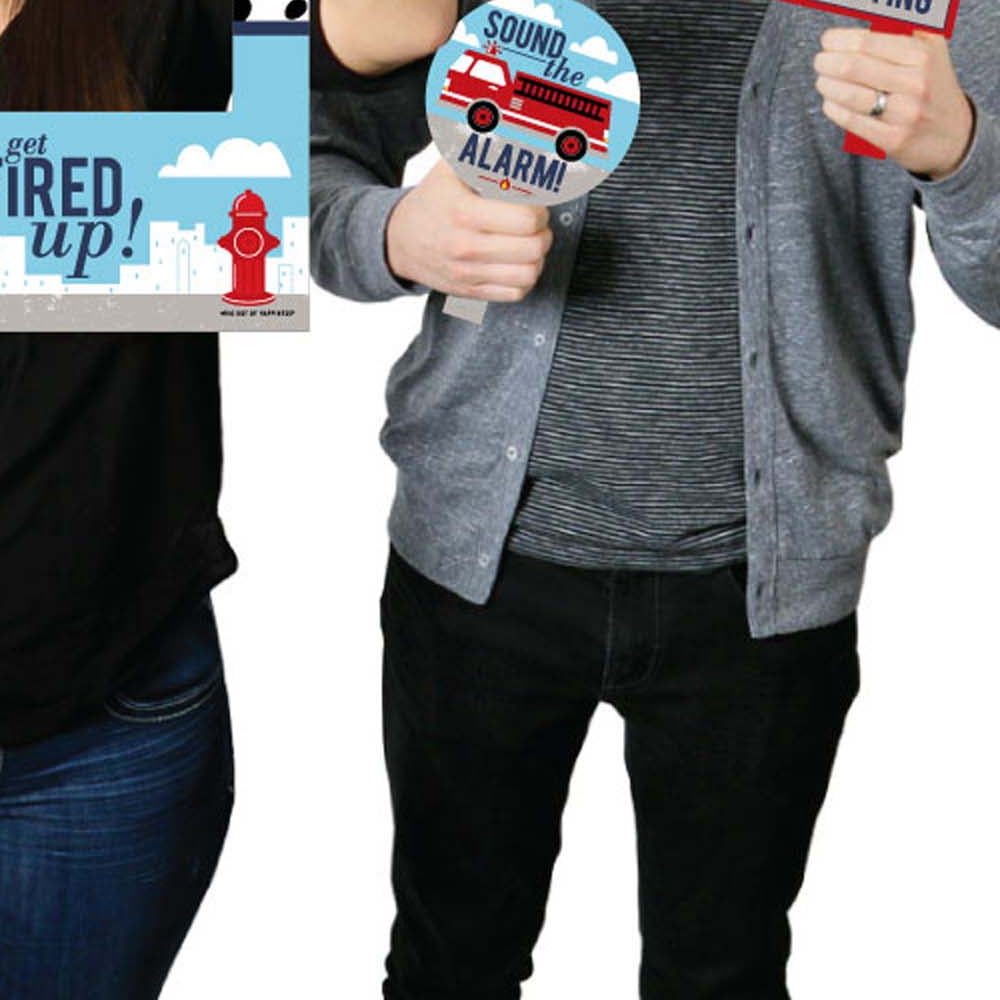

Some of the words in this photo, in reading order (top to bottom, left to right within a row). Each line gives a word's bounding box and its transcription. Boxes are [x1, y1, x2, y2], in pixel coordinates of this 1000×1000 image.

[483, 10, 567, 59] SOUND
[543, 56, 585, 87] the
[4, 133, 48, 164] get
[458, 133, 567, 194] ALARM!
[31, 197, 143, 279] up!
